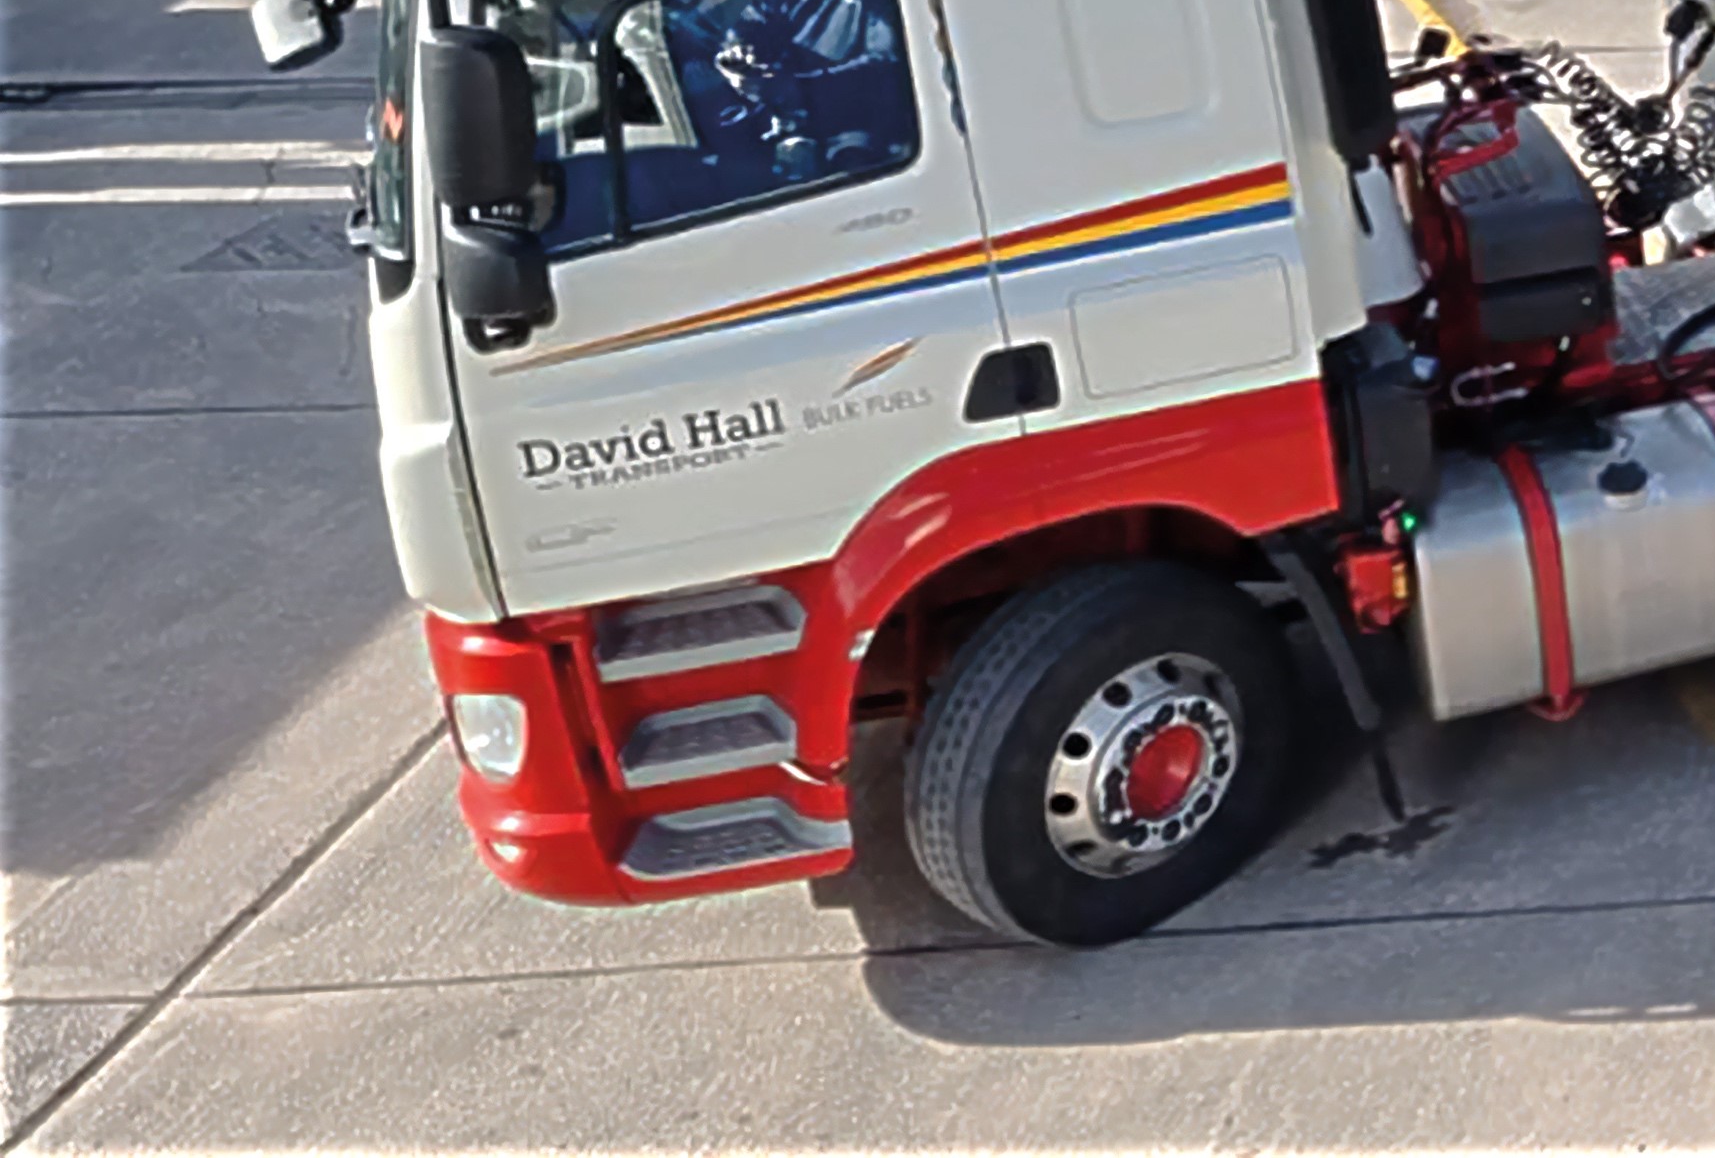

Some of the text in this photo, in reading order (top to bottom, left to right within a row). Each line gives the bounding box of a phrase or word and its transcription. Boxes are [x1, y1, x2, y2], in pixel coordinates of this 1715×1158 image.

[803, 387, 933, 430] BULK FUELS
[517, 398, 786, 478] David Hall
[568, 445, 749, 490] TRANSPORT
